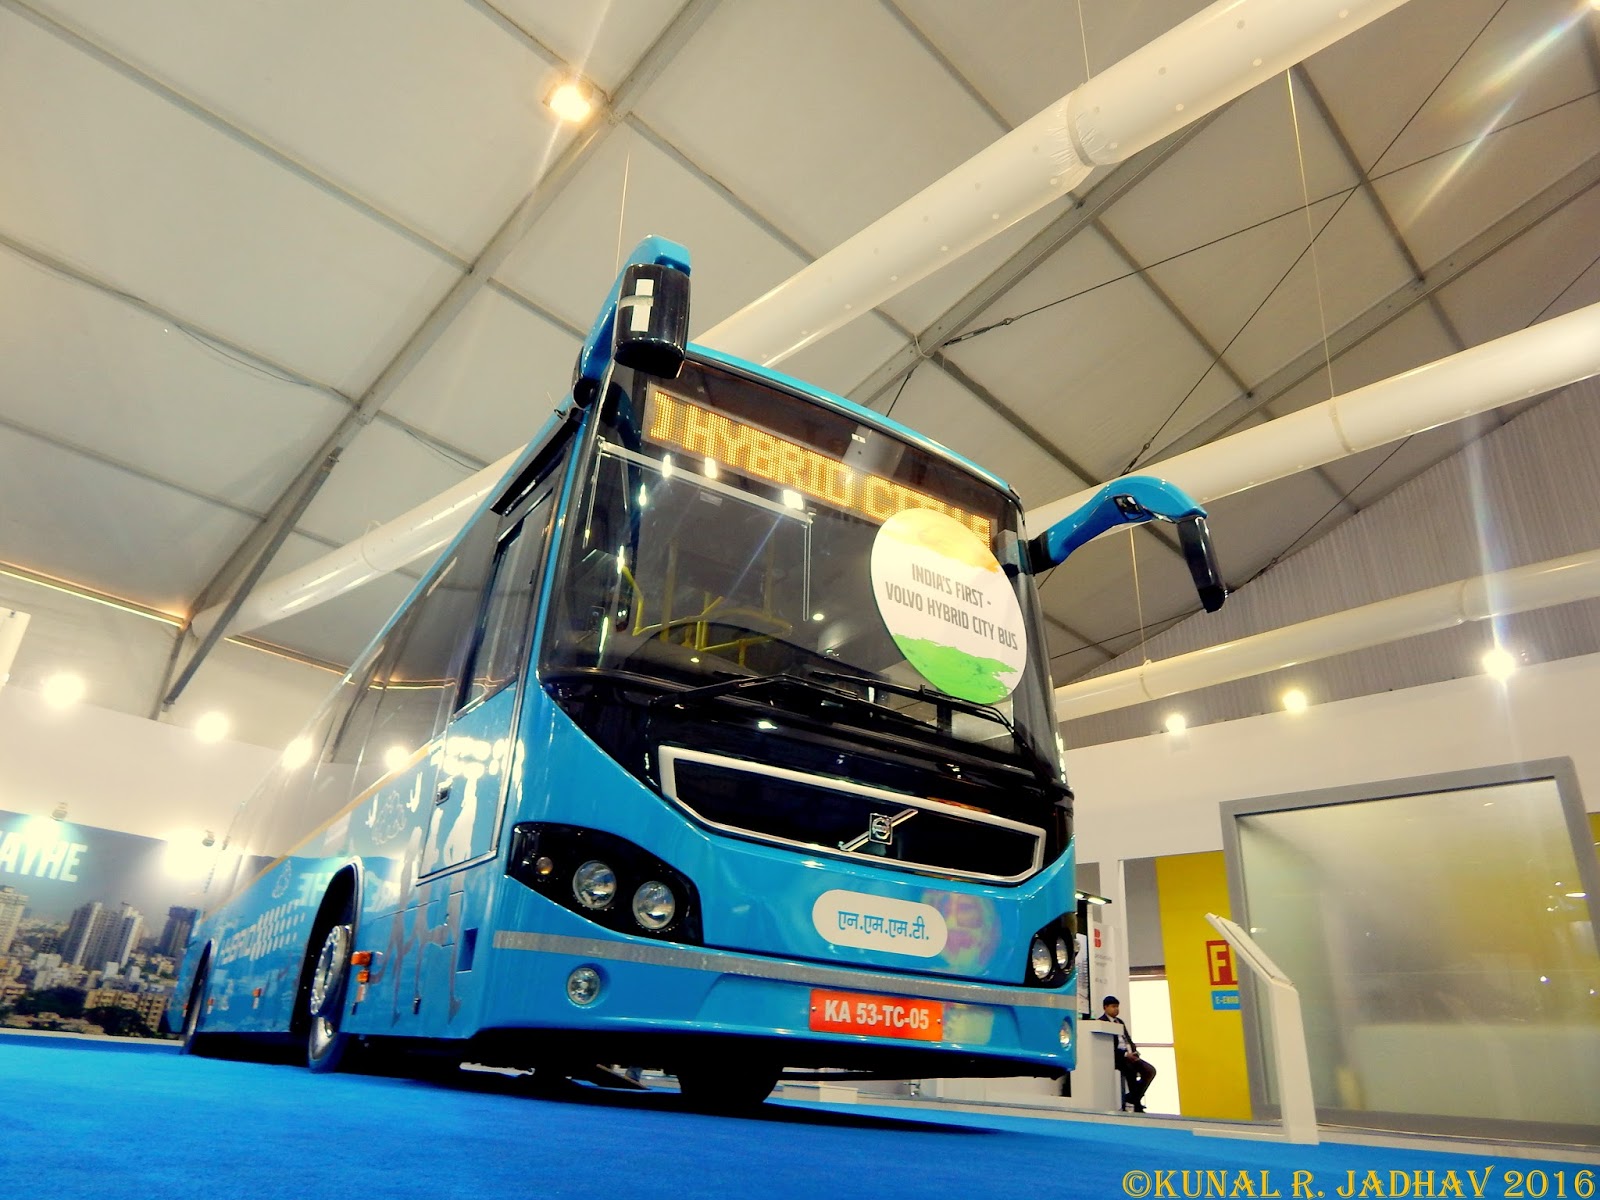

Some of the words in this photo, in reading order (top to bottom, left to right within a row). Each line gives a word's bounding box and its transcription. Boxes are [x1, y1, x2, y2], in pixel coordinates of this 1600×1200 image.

[682, 404, 855, 508] HYBRID
[911, 563, 953, 596] INDIA'S
[955, 581, 984, 609] FIRST
[885, 581, 923, 612] VOLVO
[927, 597, 970, 630] HYBRID
[972, 616, 995, 640] CITY
[998, 626, 1018, 650] BUS
[824, 999, 852, 1023] KA
[856, 1002, 929, 1030] 53-TC-05
